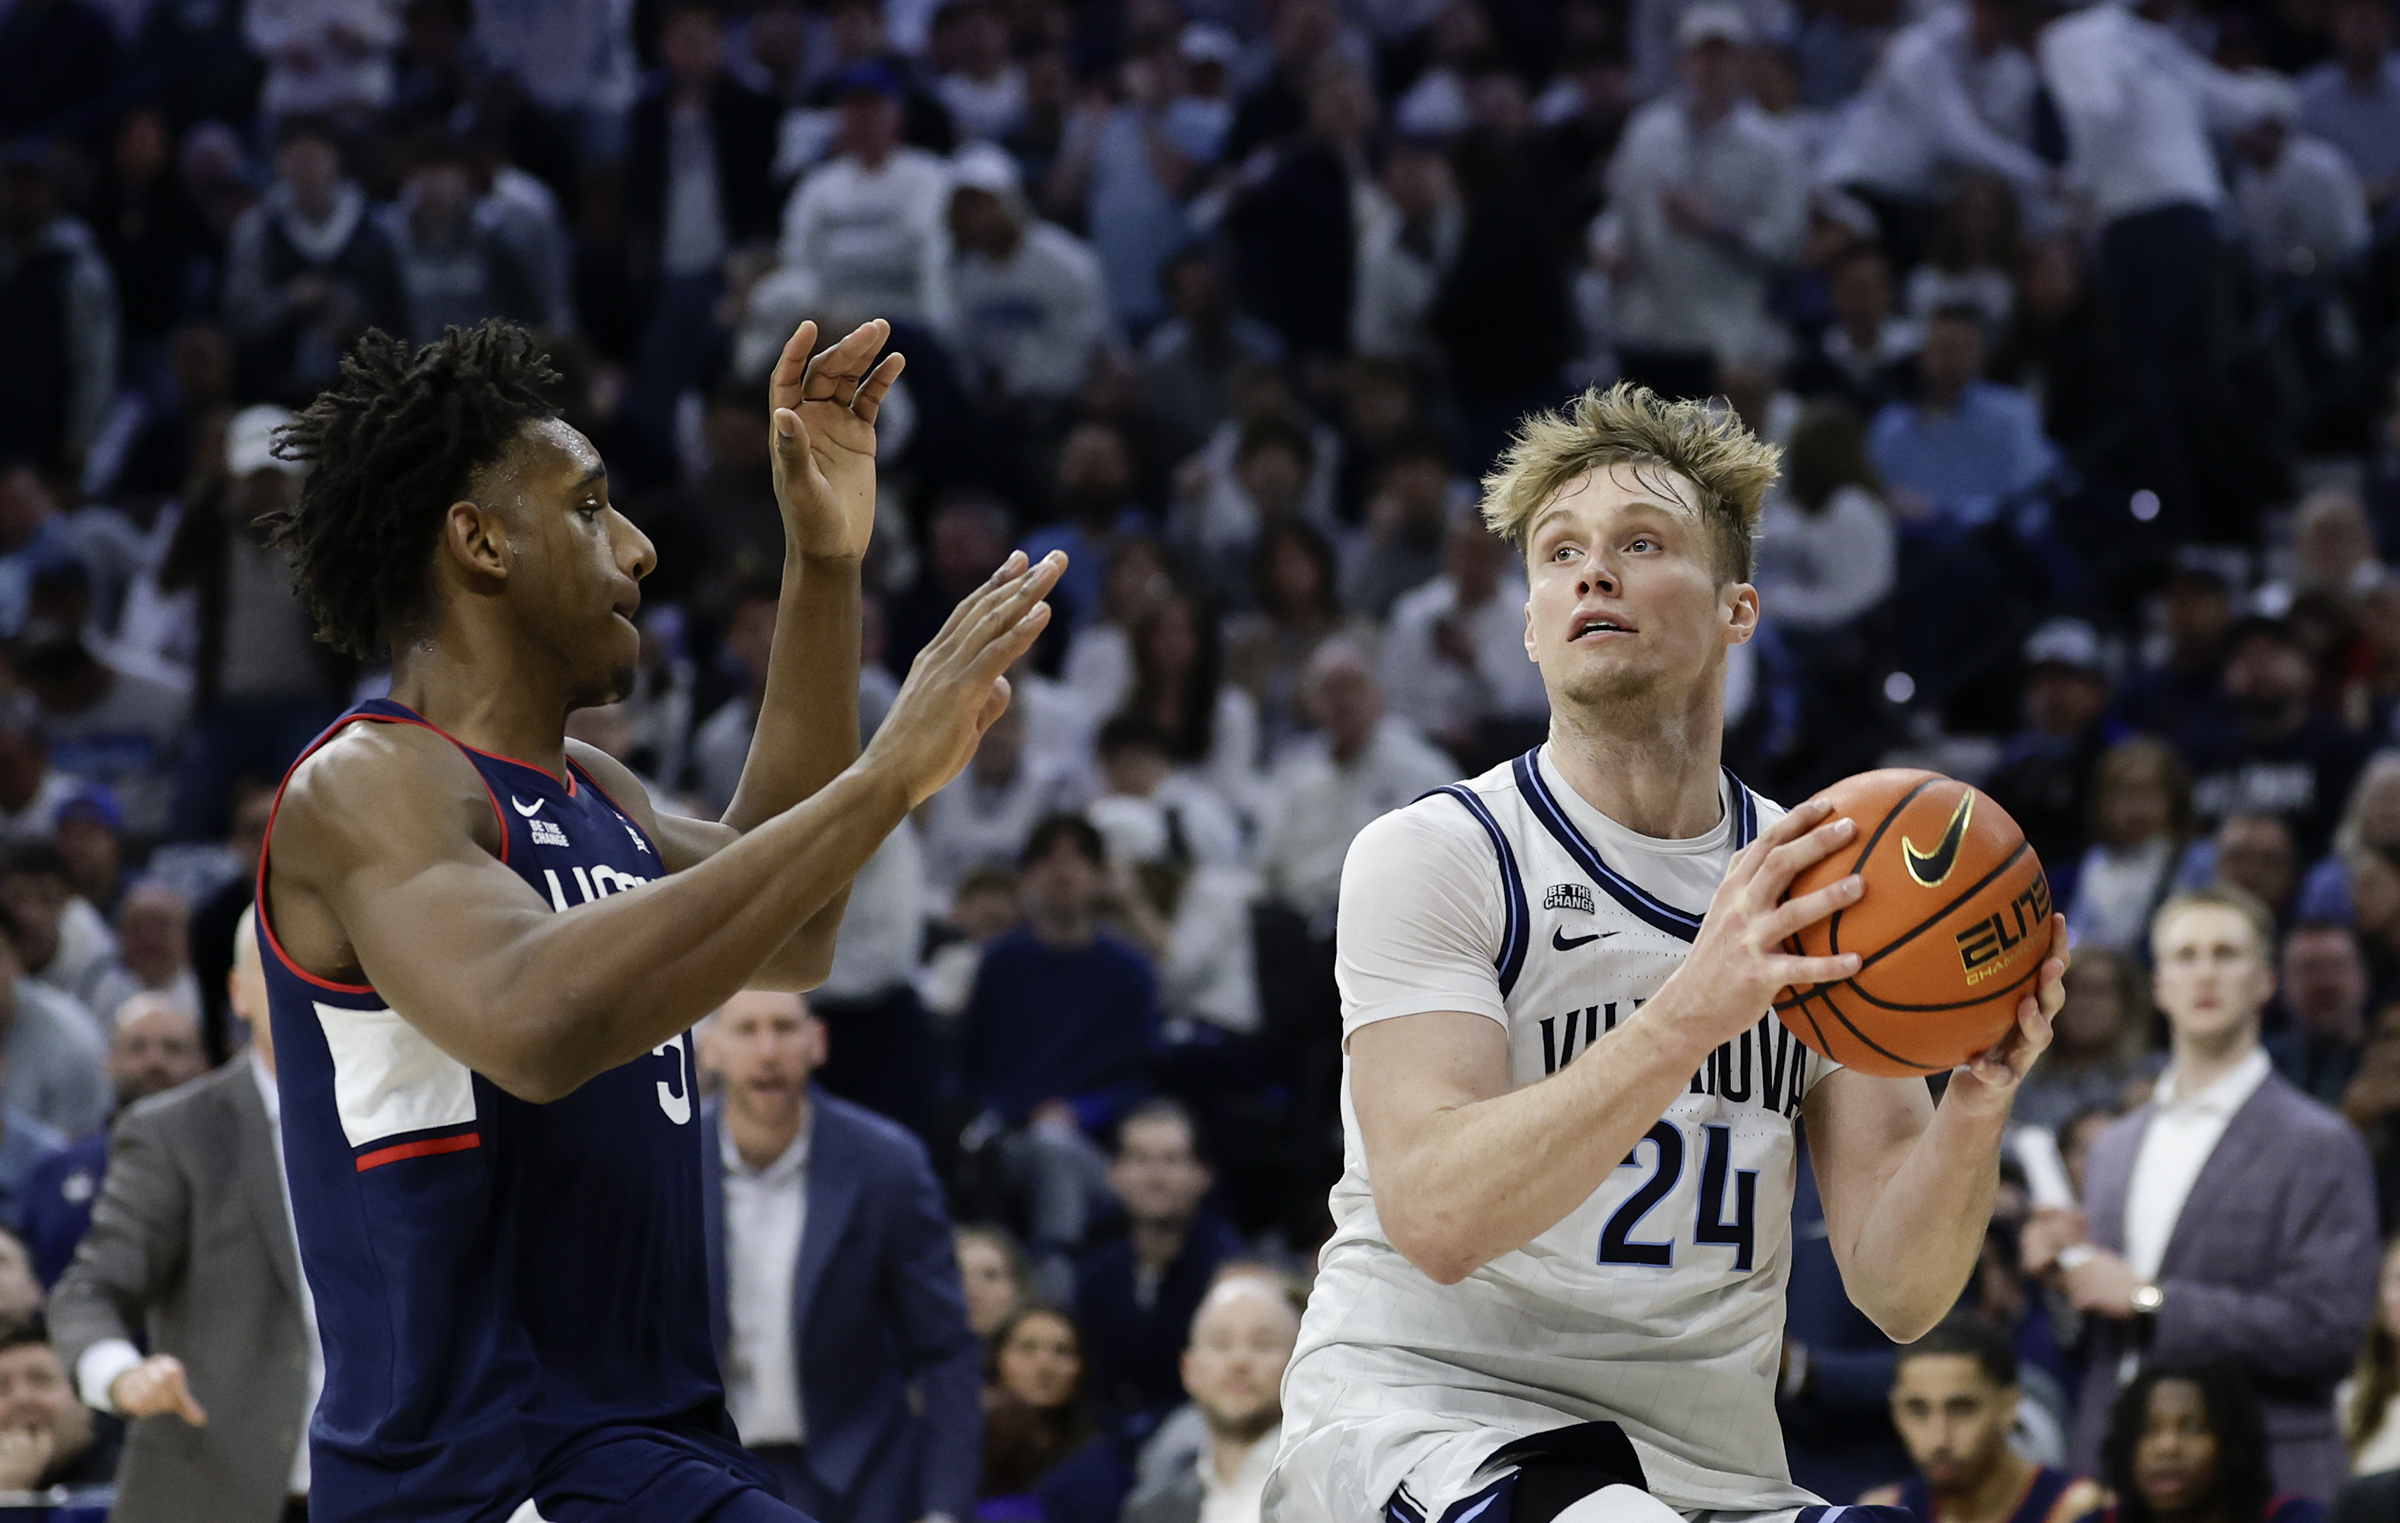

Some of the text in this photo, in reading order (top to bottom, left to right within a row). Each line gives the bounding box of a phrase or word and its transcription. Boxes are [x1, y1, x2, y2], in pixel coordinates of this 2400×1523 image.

[529, 819, 562, 835] BE THE
[531, 831, 570, 848] CHANGE
[1547, 884, 1592, 901] BE THE
[1544, 896, 1595, 915] CHANGE
[1955, 867, 2050, 972] ELITE
[1596, 1117, 1760, 1272] 24
